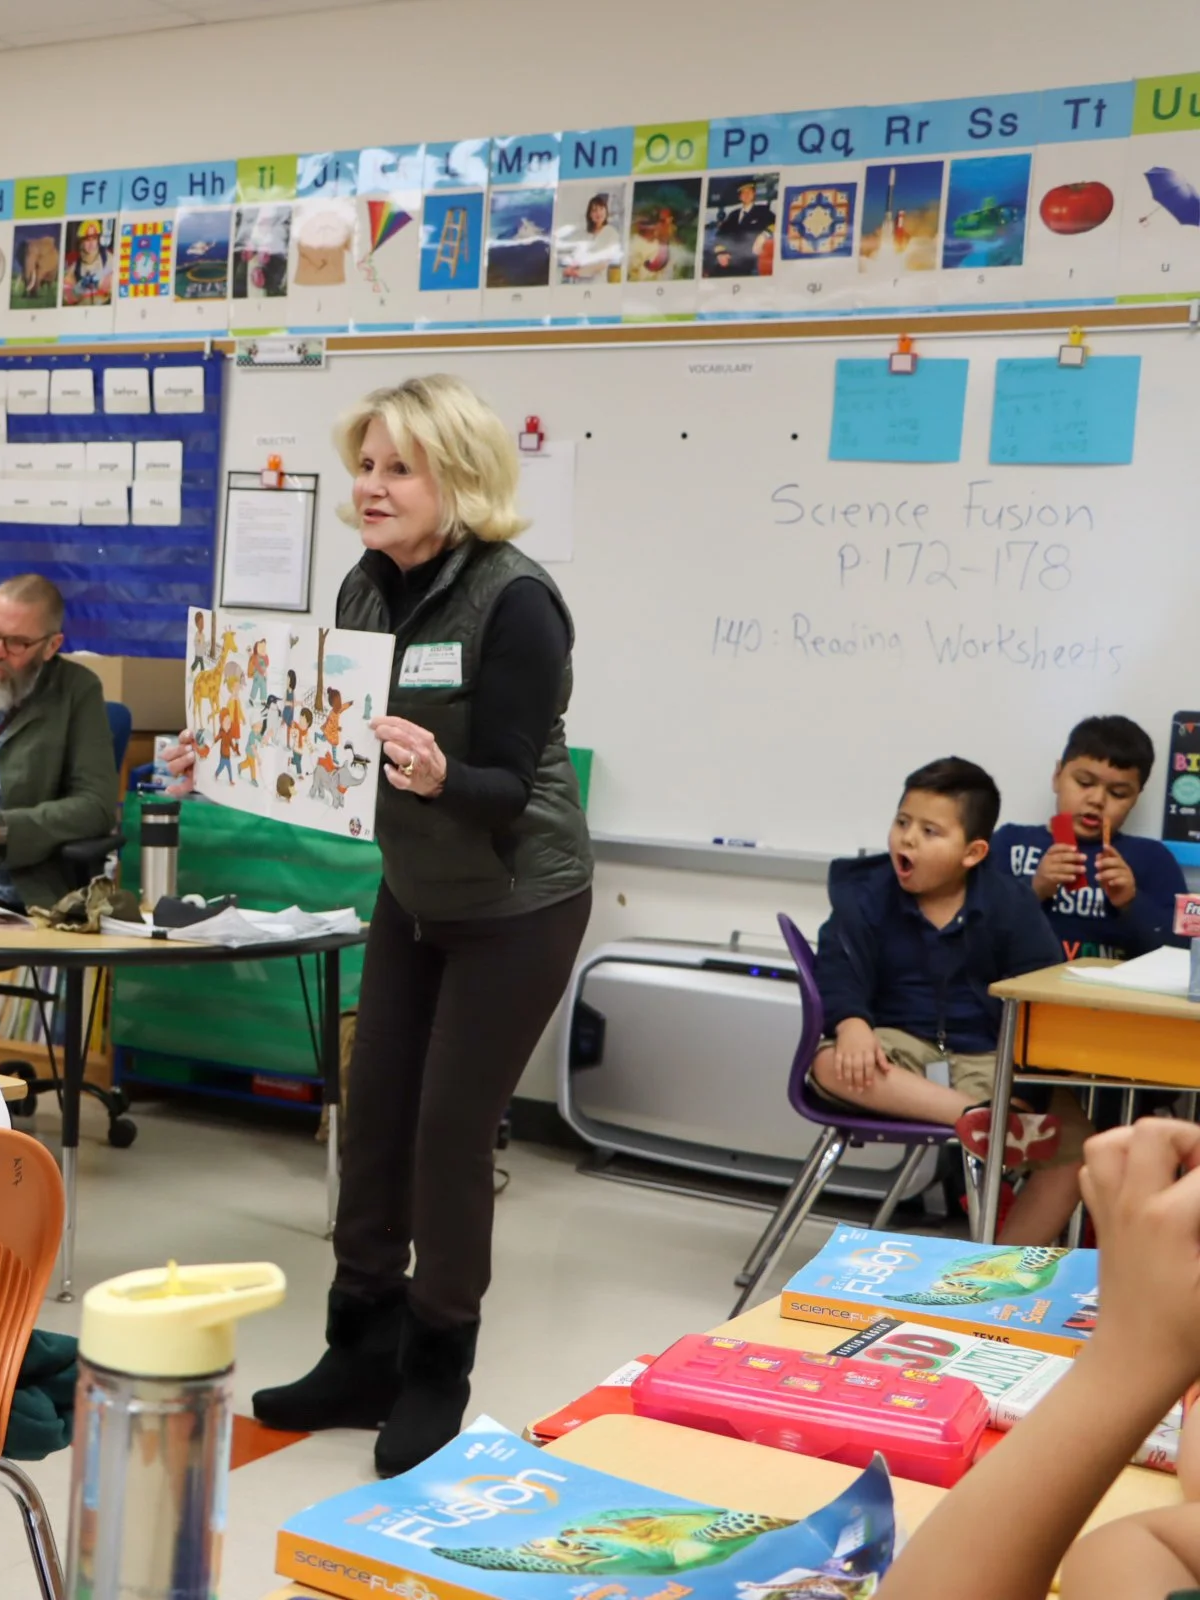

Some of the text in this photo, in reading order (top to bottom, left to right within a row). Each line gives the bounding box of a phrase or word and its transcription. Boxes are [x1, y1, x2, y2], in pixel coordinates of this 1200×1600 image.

[24, 186, 56, 211] Ee
[80, 180, 108, 205] Ff
[131, 176, 168, 206] Gg
[189, 172, 226, 197] Hh
[498, 146, 553, 175] Mm
[573, 140, 618, 169] Nn
[644, 133, 694, 163] Oo
[722, 128, 769, 163] Pp
[798, 123, 855, 158] Qq
[884, 114, 931, 146] Rr
[967, 107, 1019, 139] Ss
[1063, 97, 1107, 130] Tt
[1160, 262, 1170, 272] u
[770, 480, 1095, 531] Science Fusion
[924, 619, 1124, 675] Worksheets
[864, 1333, 961, 1370] 3D
